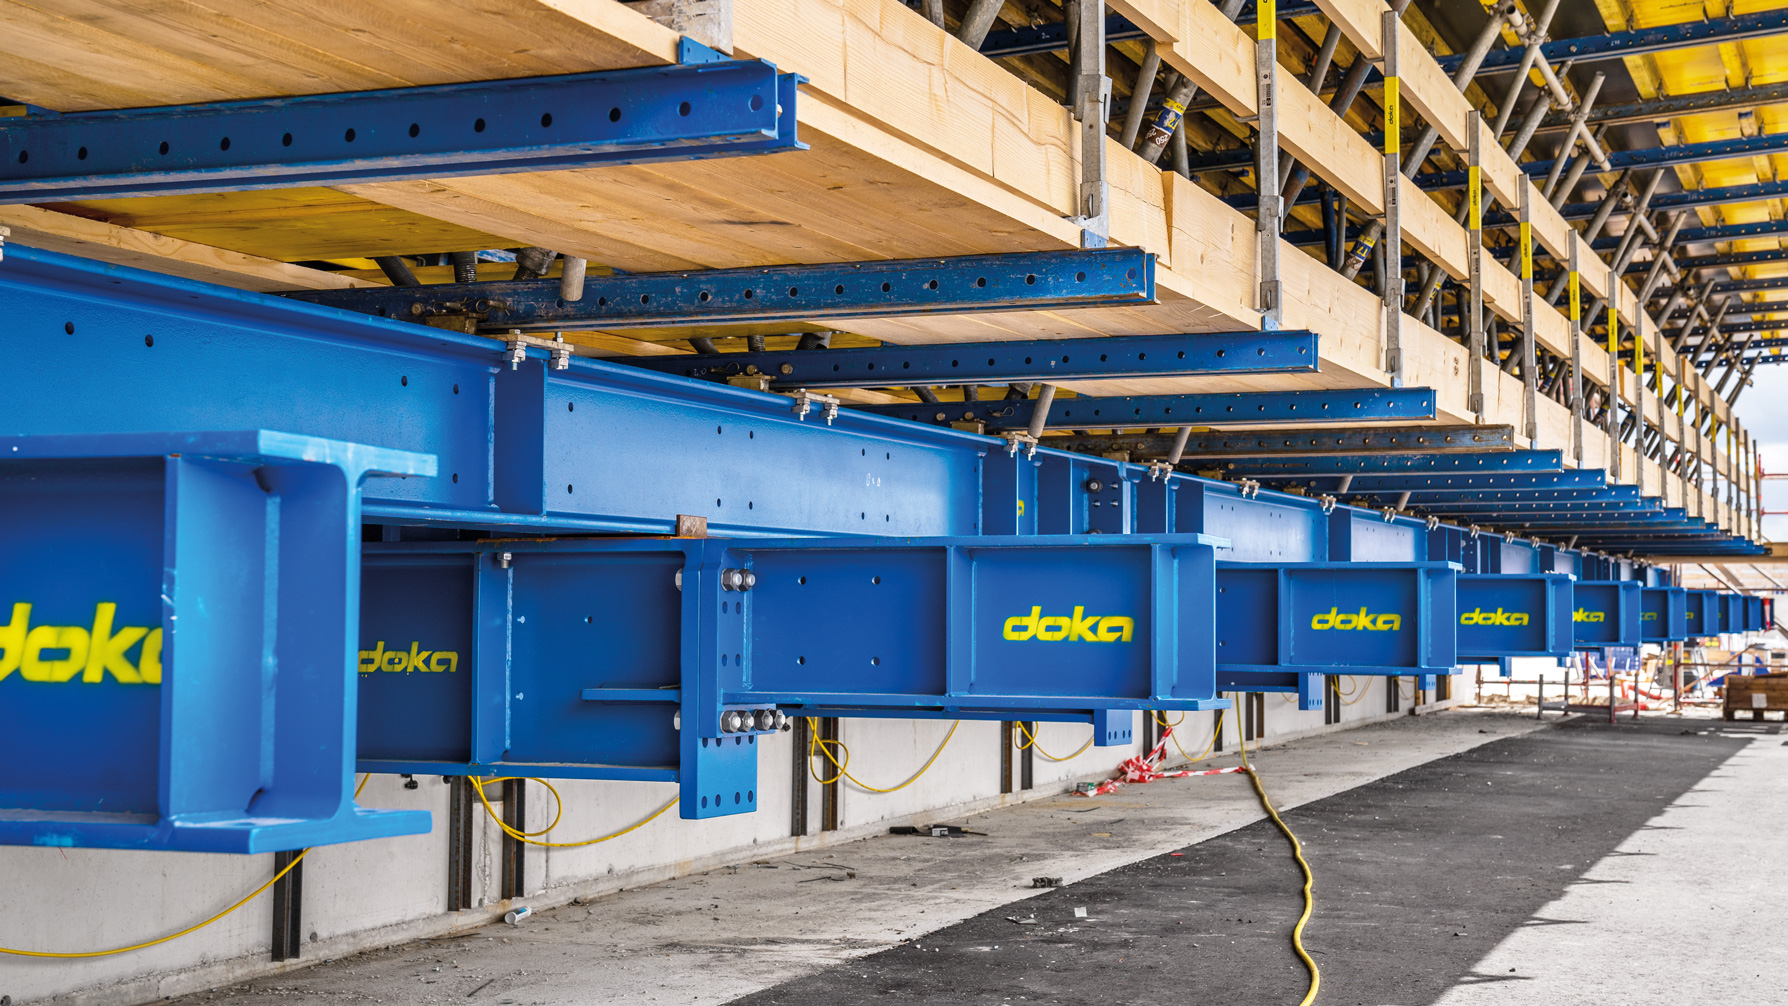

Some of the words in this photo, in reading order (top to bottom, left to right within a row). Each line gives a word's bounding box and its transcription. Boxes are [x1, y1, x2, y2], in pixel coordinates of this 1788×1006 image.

[1155, 134, 1169, 145] 250
[1002, 605, 1135, 642] doka
[1311, 606, 1402, 631] doka
[1460, 607, 1529, 626] doka
[358, 641, 459, 673] doka
